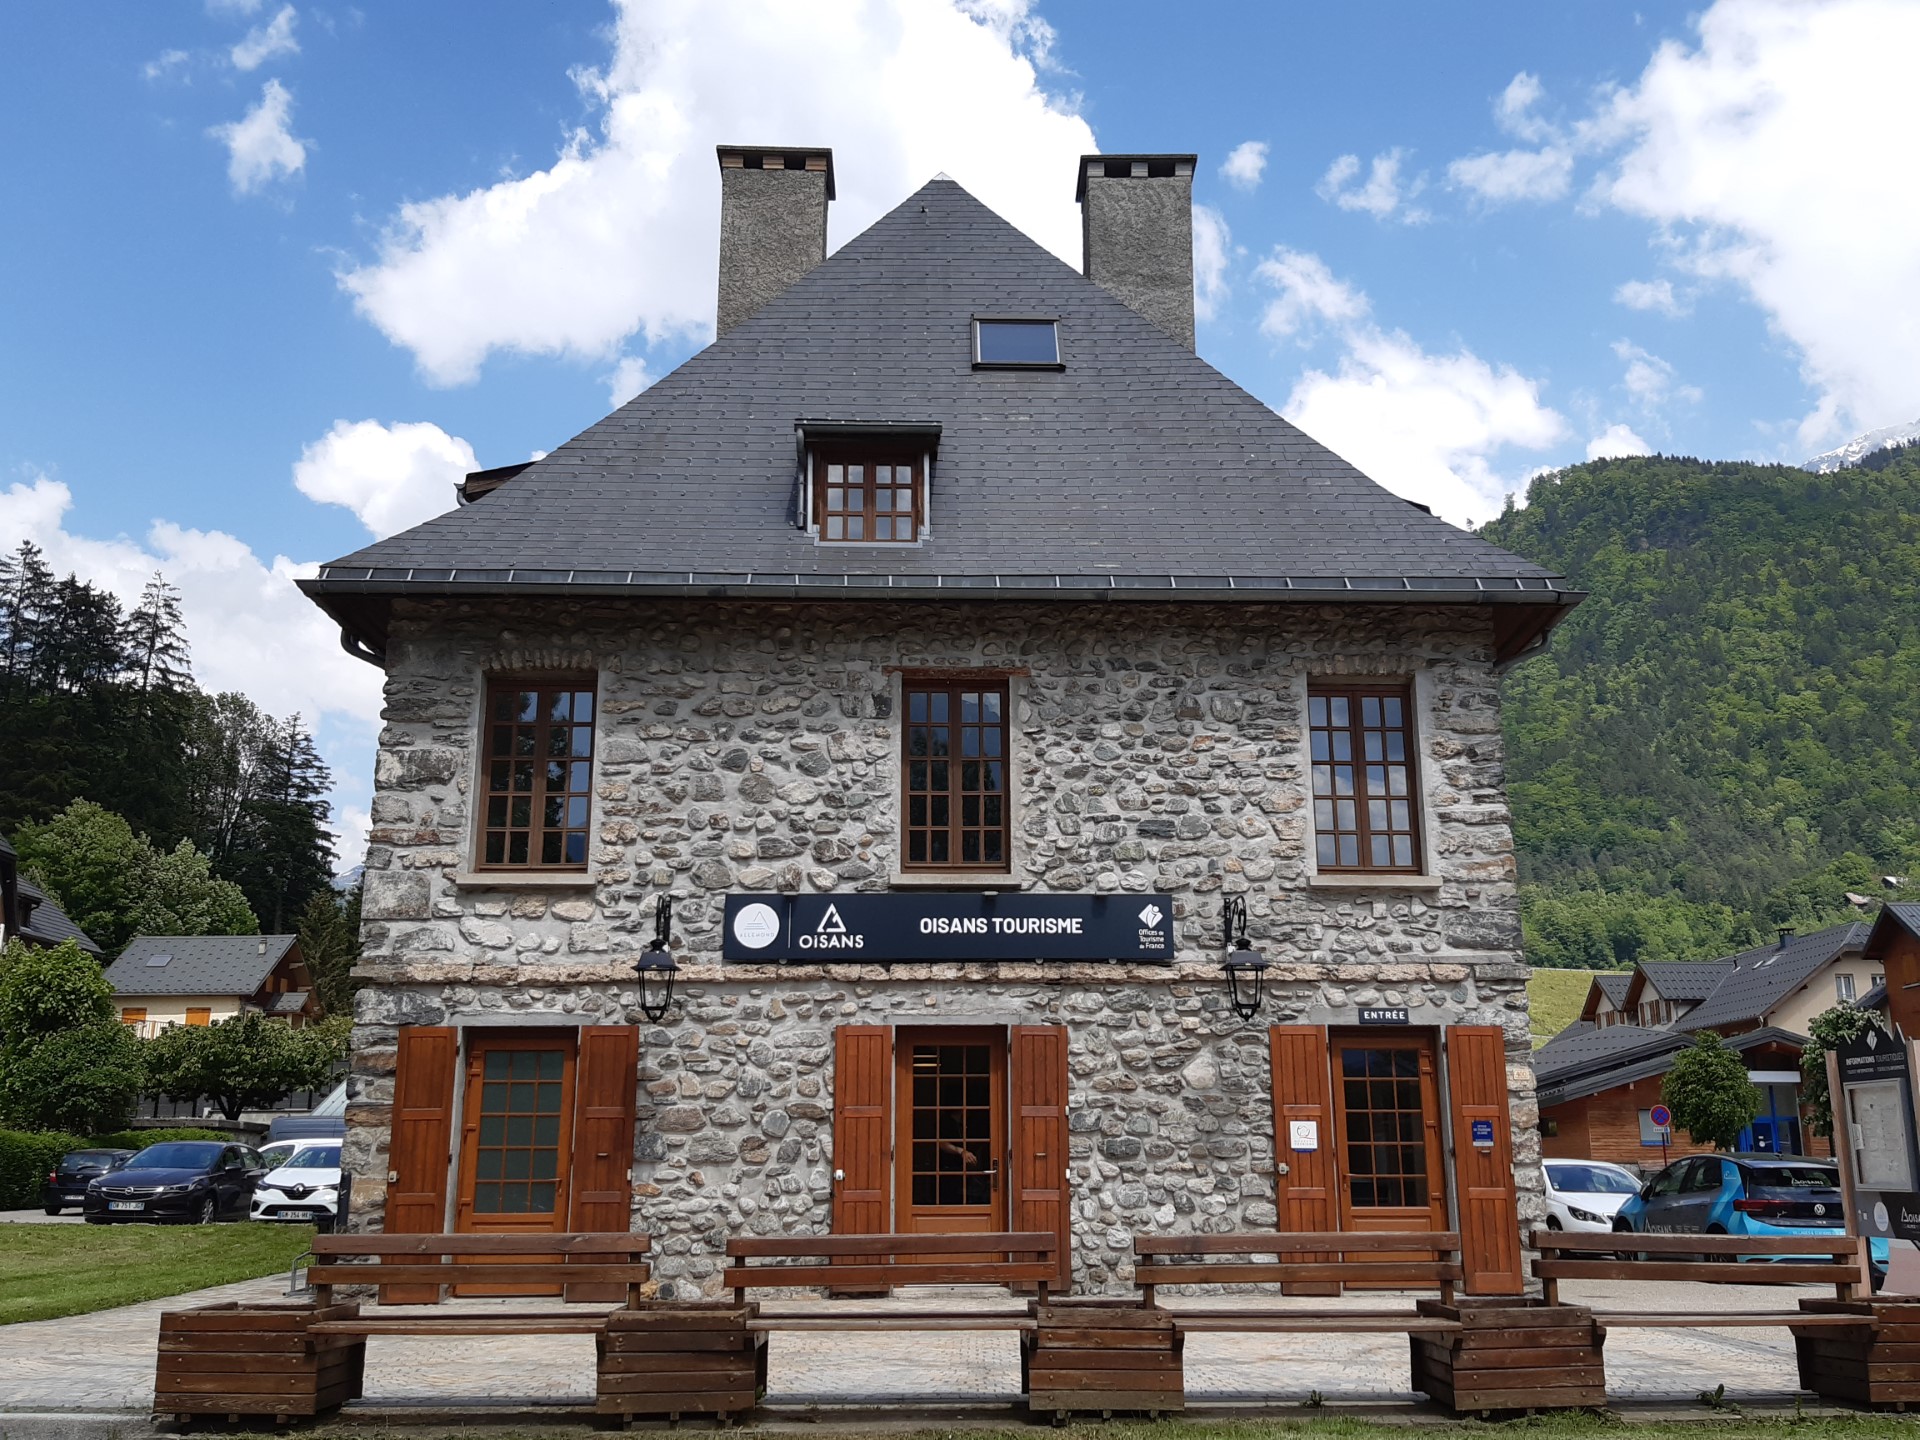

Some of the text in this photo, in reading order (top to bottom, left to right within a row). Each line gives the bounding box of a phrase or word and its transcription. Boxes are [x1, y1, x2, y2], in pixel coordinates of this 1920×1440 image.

[920, 917, 1083, 934] OISANS TOURISME
[1363, 1009, 1406, 1020] ENTRÉE
[1845, 1055, 1875, 1066] INFORMATIONS
